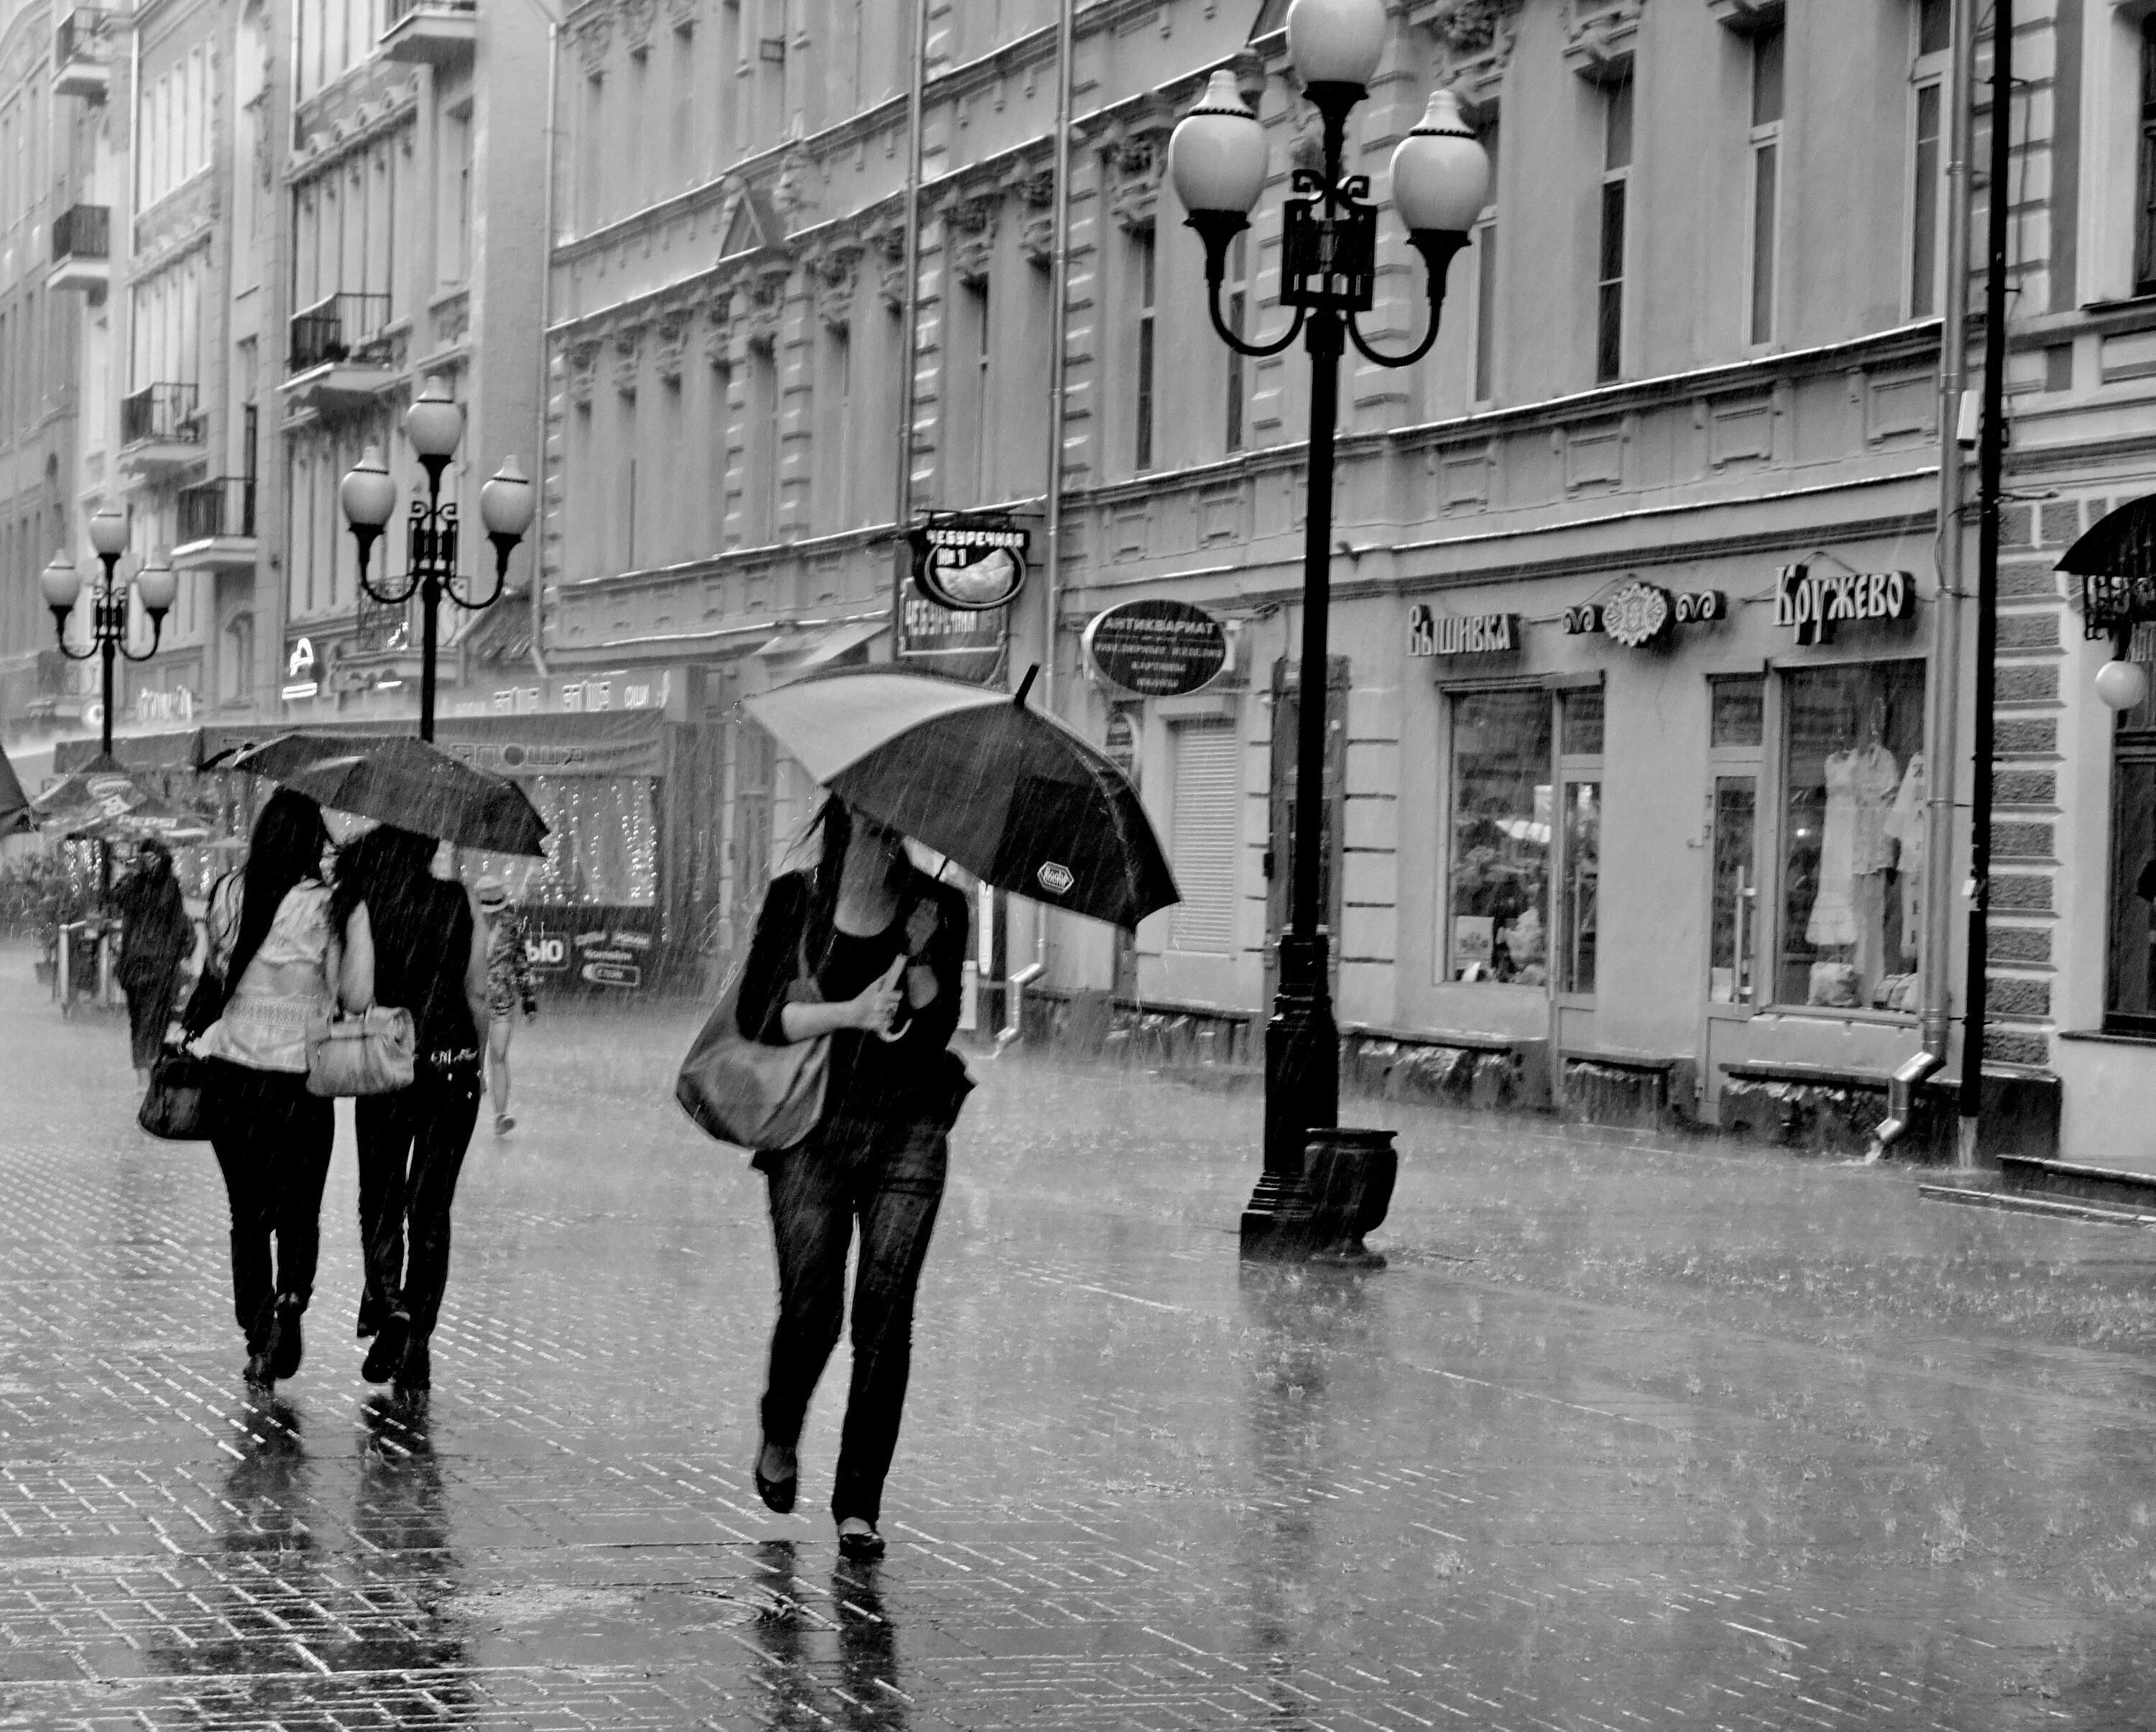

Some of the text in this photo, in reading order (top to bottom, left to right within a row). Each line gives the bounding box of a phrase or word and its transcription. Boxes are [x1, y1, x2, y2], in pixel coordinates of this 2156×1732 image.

[926, 530, 1024, 548] ЧЕБУРЕЧНАЯ
[1772, 563, 1907, 645] Кружево
[1102, 617, 1216, 635] АНТИКВАРИАТ
